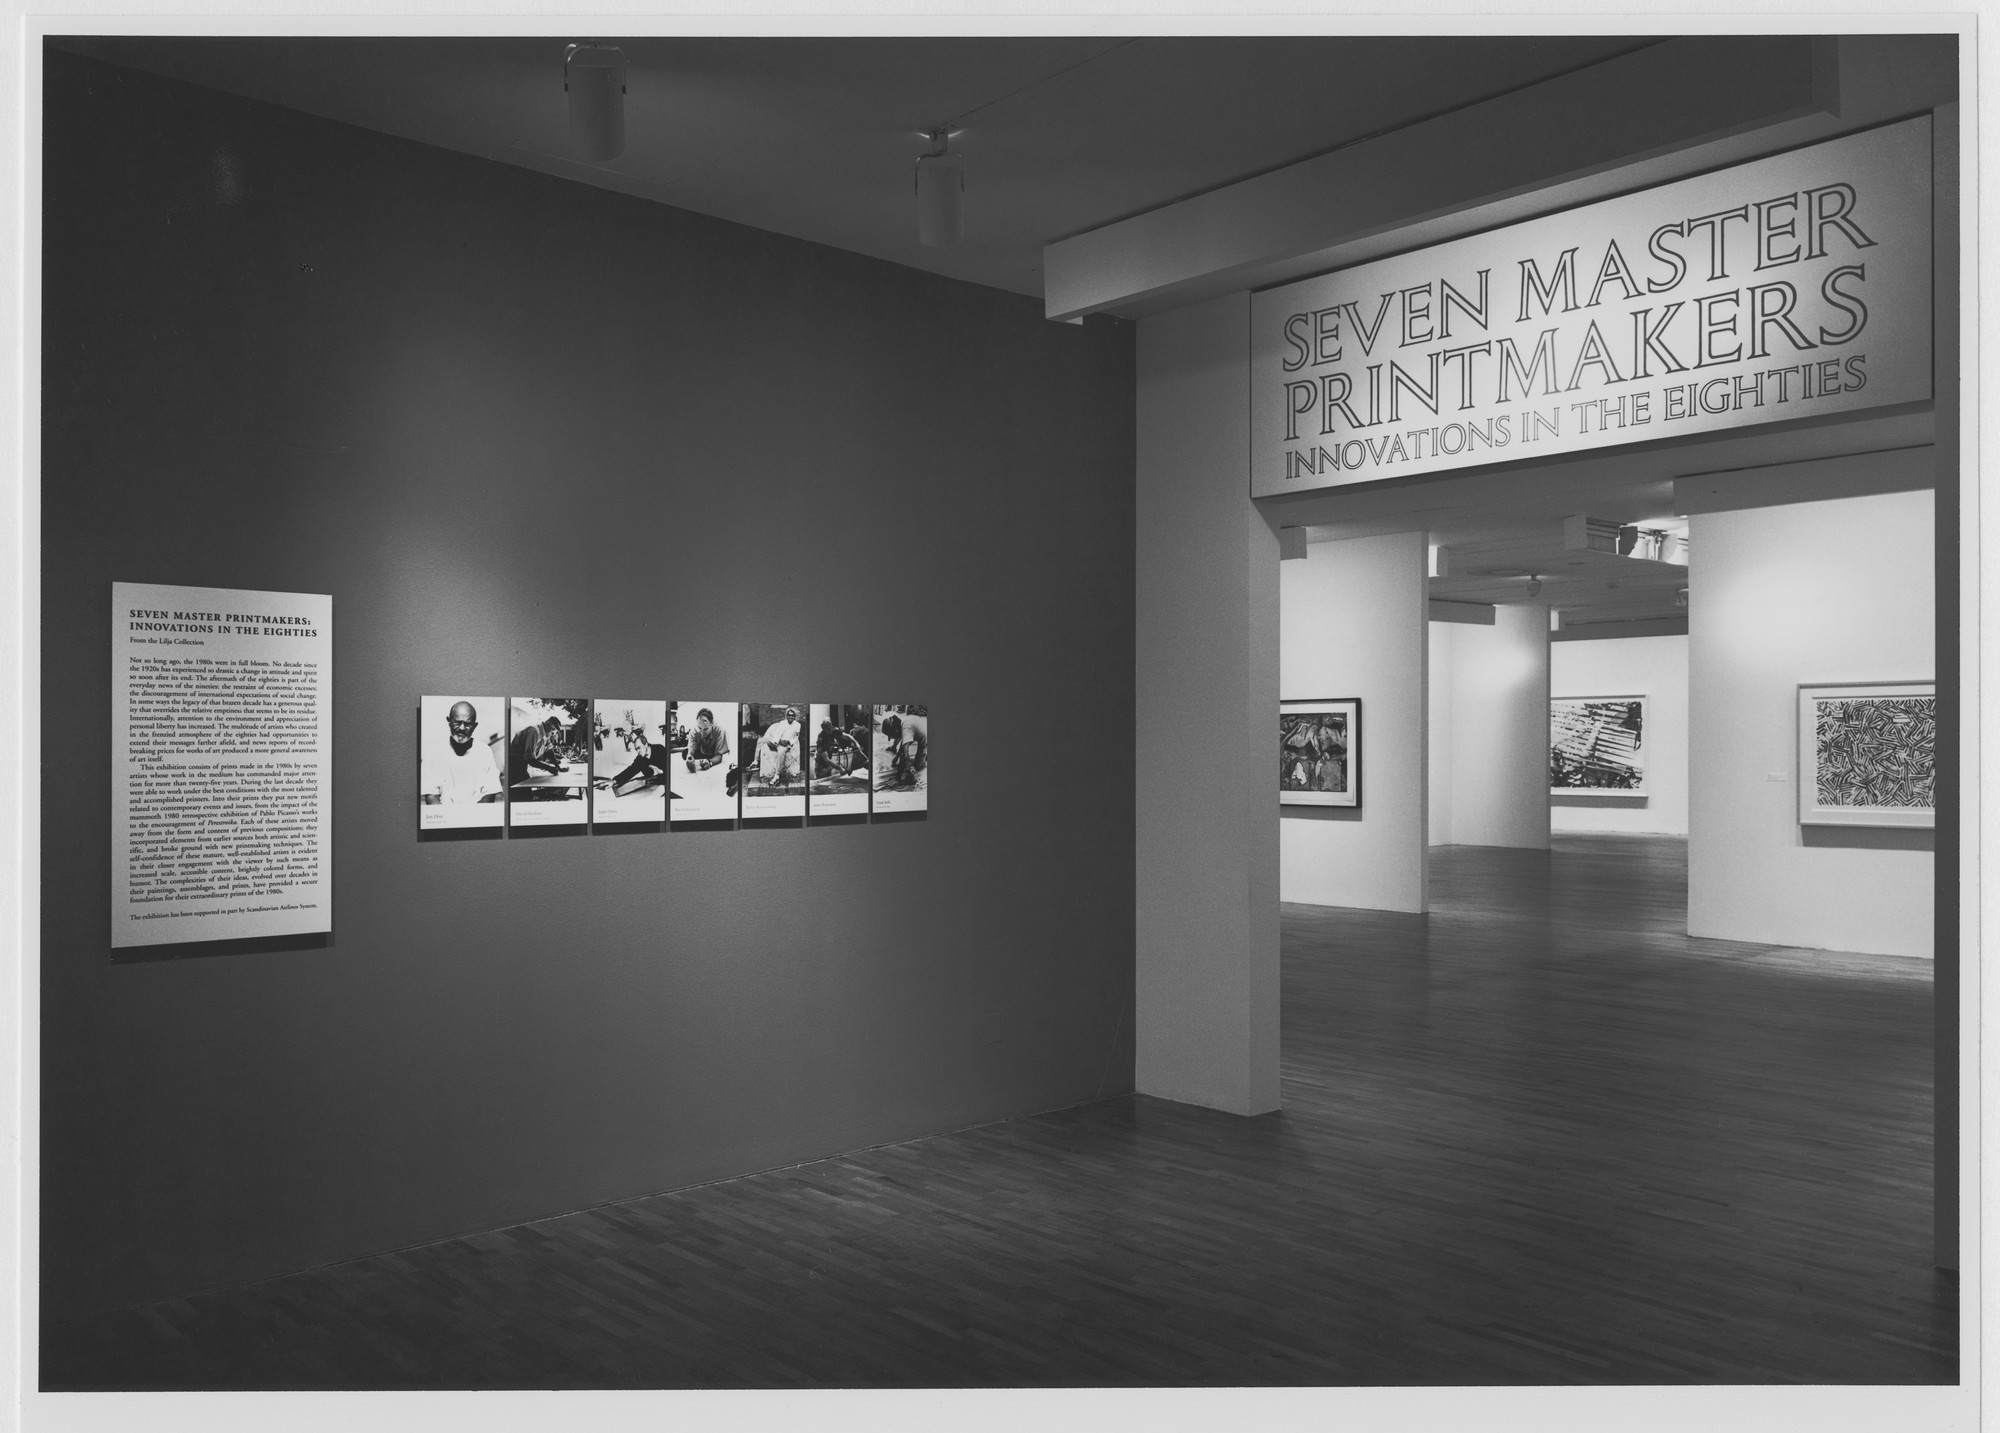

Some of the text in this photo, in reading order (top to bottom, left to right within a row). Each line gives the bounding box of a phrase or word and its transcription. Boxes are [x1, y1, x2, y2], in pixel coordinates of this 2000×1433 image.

[1282, 182, 1879, 373] SEVEN MASTER
[1283, 263, 1869, 442] PRINTMAKERS
[1285, 354, 1868, 480] INNOVATIONS IN THE EIGHTIES
[129, 609, 311, 626] SEVEN MASTER PRINTMAKERS:
[130, 621, 317, 638] INNOVATIONS IN THE EIGHTIES
[129, 636, 205, 647] From the Lilja Collection
[195, 658, 213, 666] 1980s
[141, 664, 160, 672] 1920s
[172, 665, 207, 676] experienced
[215, 666, 235, 674] drastic
[240, 667, 261, 677] change
[129, 680, 156, 691] everyday
[155, 673, 280, 686] after aftermath eighties
[141, 689, 188, 700] discouragement
[197, 690, 235, 698] international
[236, 692, 271, 701] expectations
[182, 698, 201, 708] legacy
[242, 699, 262, 707] decade
[152, 706, 242, 717] overrides relative emptiness
[129, 722, 155, 732] personal
[156, 722, 176, 732] liberty
[151, 730, 176, 738] frenzied
[178, 730, 212, 740] atmosphere
[235, 731, 257, 741] eighties
[169, 741, 196, 749] messages
[129, 747, 156, 757] breaking
[157, 748, 175, 757] prices
[221, 747, 249, 757] produced
[156, 763, 187, 771] exhibition
[220, 764, 238, 773] prints
[150, 771, 169, 779] whose
[246, 770, 282, 778] commanded
[188, 779, 221, 789] twenty-five
[240, 778, 262, 788] During
[183, 787, 201, 795] under
[225, 786, 256, 794] conditions
[143, 794, 260, 806] accomplished their prints
[129, 804, 151, 813] related
[160, 804, 202, 814] contemporary
[129, 812, 162, 821] mammoth
[164, 812, 180, 820] 1980
[182, 812, 218, 822] retrospective
[220, 810, 249, 818] exhibition
[259, 809, 276, 817] Pablo
[150, 821, 197, 831] encouragement
[265, 817, 279, 825] these
[240, 826, 264, 836] previous
[129, 837, 169, 848] incorporated
[169, 836, 196, 844] elements
[213, 834, 231, 843] earlier
[161, 844, 179, 853] broke
[181, 844, 203, 854] ground
[235, 841, 271, 852] printmaking
[129, 853, 175, 862] self-confidence
[185, 852, 201, 860] these
[227, 849, 271, 858] well-established
[129, 870, 158, 879] increased
[180, 867, 208, 876] accessible
[237, 865, 260, 876] brightly
[263, 864, 284, 872] colored
[139, 862, 155, 870] their
[157, 861, 175, 869] closer
[178, 860, 213, 871] engagement
[169, 876, 207, 887] complexities
[217, 874, 231, 883] their
[251, 872, 273, 881] evolved
[129, 887, 145, 896] their
[129, 894, 164, 904] foundation
[174, 893, 189, 901] their
[190, 890, 229, 903] extraordinary
[229, 890, 247, 900] prints
[142, 904, 279, 920] exhibition supported Scandinavian
